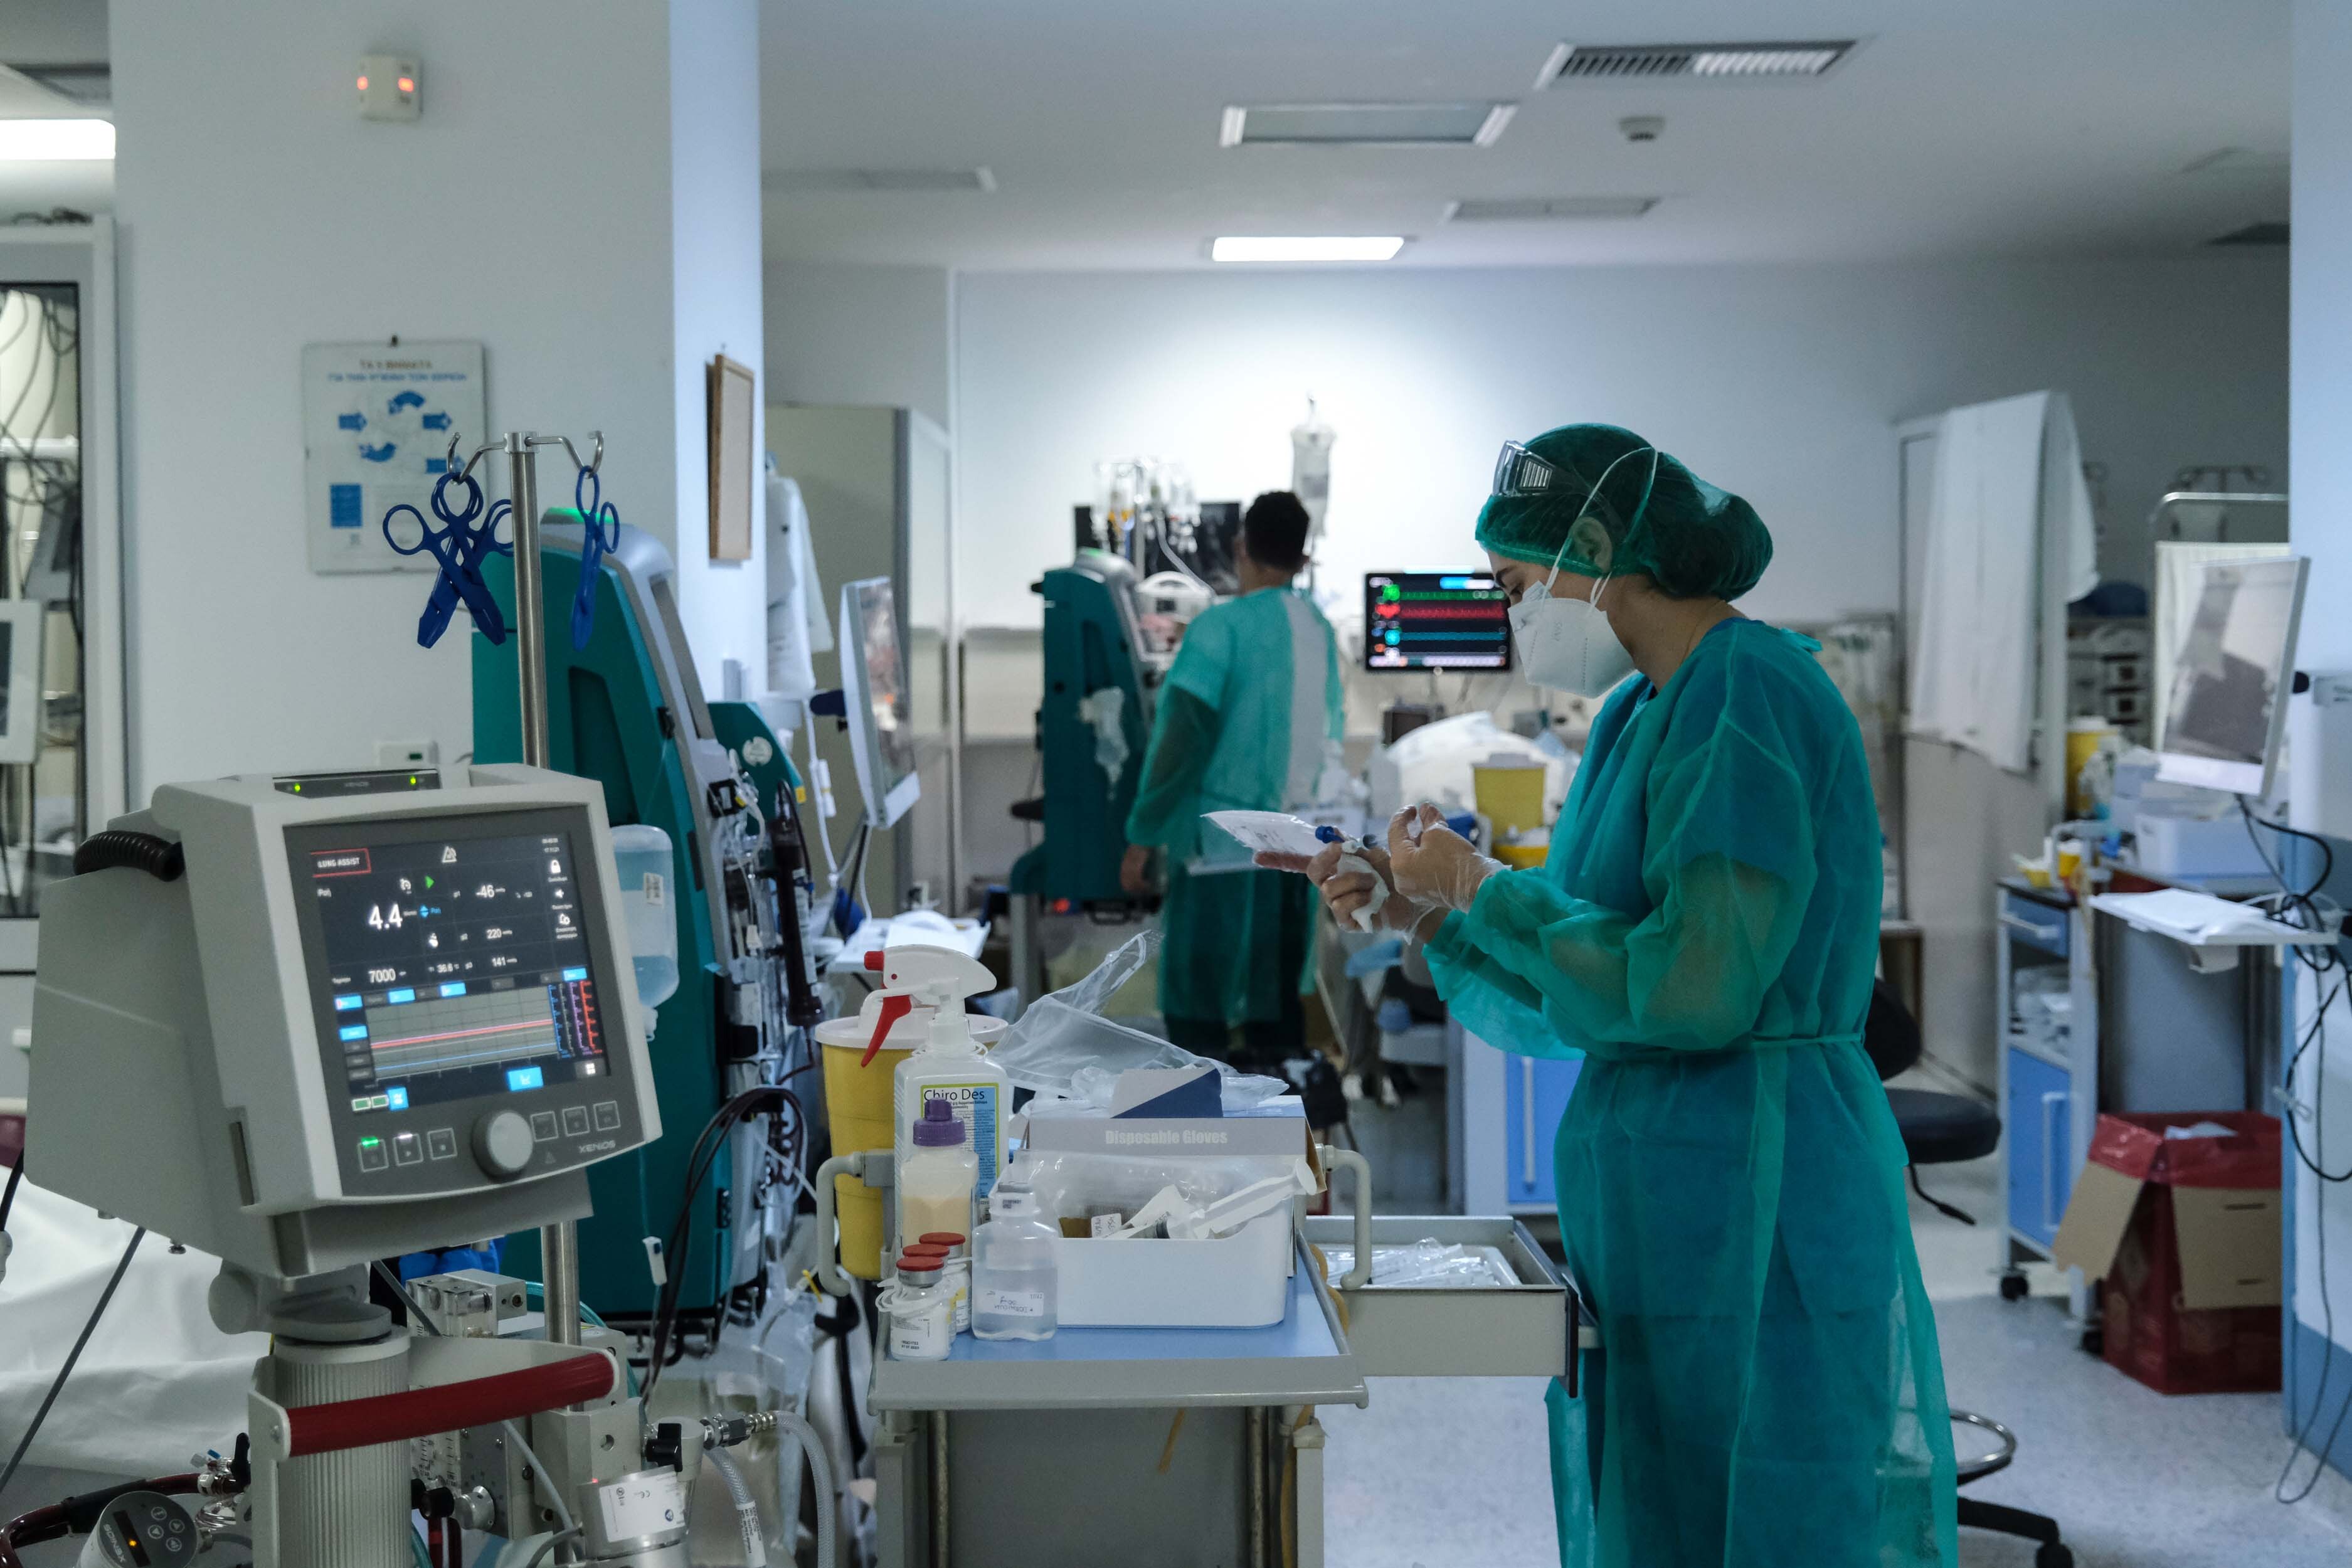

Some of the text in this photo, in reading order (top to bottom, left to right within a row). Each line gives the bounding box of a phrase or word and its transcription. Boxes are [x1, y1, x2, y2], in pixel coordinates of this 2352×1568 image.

[337, 857, 360, 866] ASSIST
[368, 903, 403, 930] 4.4
[486, 928, 502, 940] 220
[492, 956, 506, 967] 141
[368, 968, 396, 983] 7000
[924, 1088, 985, 1101] Chiro Des
[1105, 1129, 1228, 1145] Disposable Gloves
[103, 1524, 125, 1563] XENIOS
